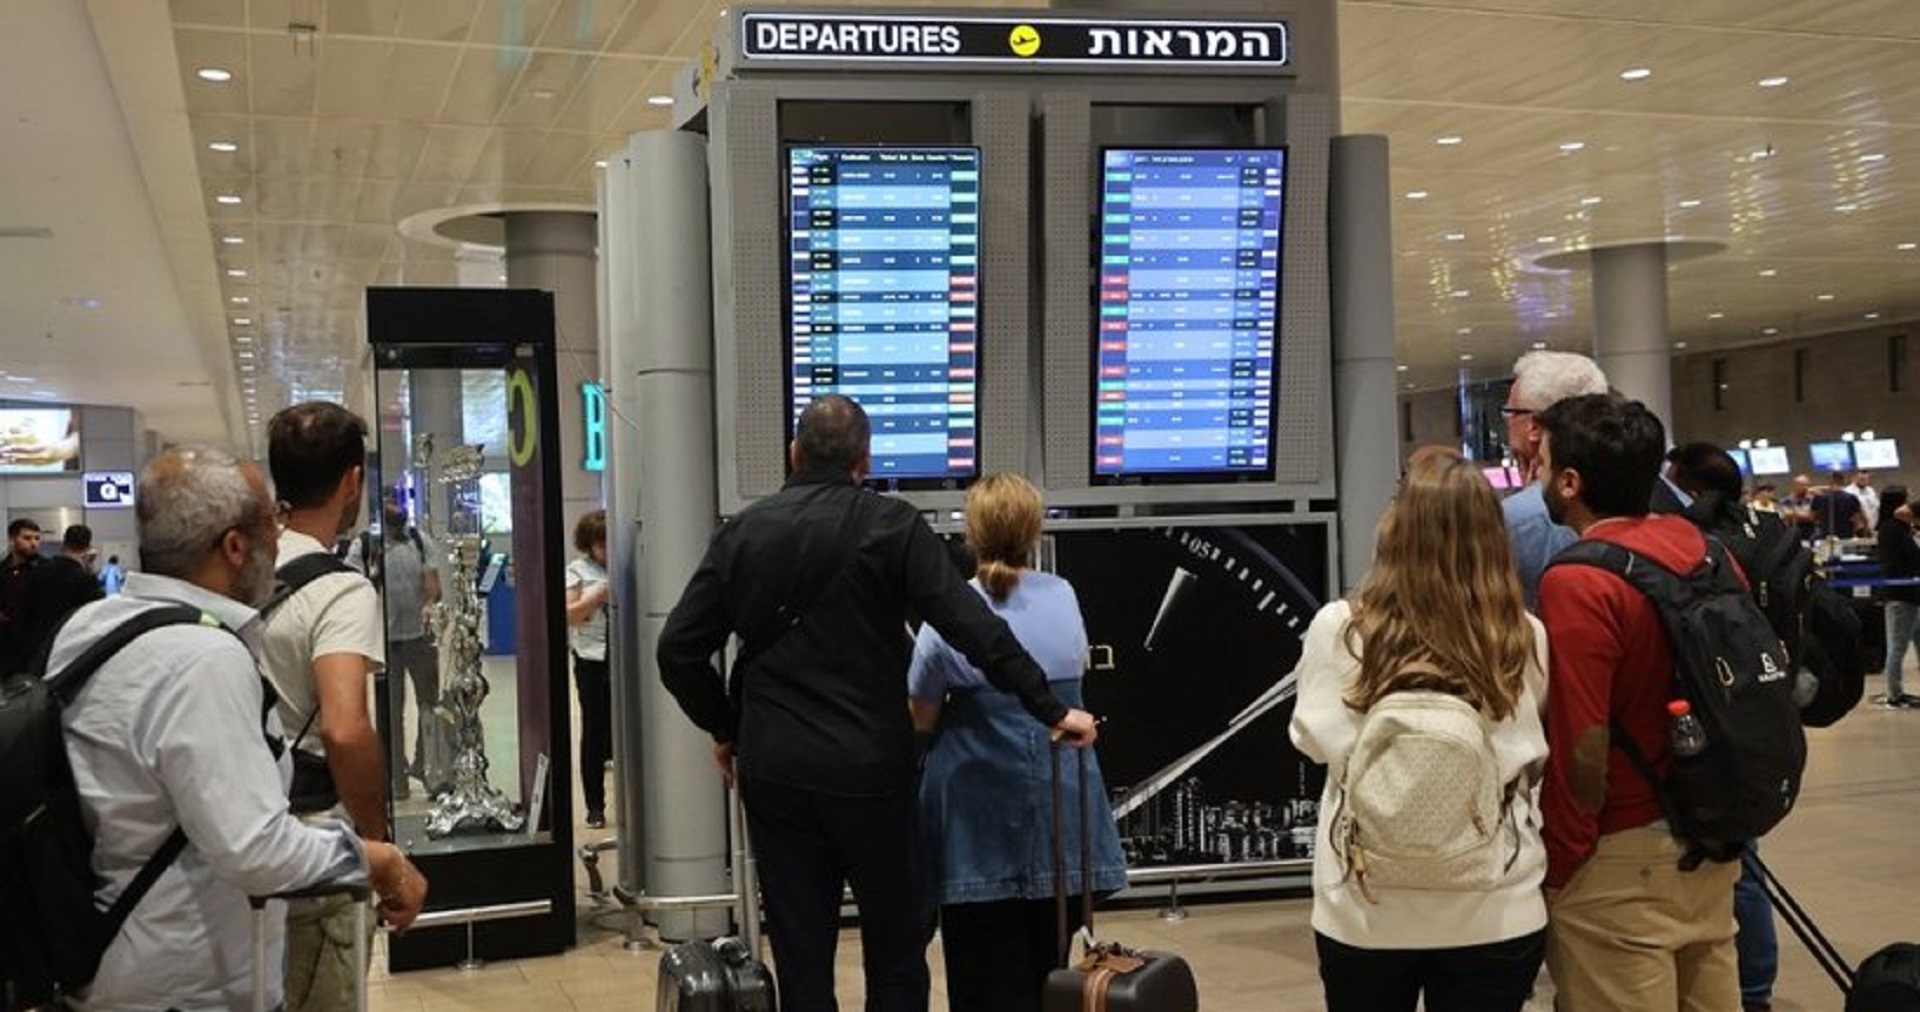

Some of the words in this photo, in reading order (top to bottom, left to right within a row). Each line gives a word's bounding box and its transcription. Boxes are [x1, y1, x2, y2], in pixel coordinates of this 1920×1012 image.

[756, 22, 960, 54] DEPARTURES
[1088, 28, 1270, 57] המראות
[1188, 536, 1212, 559] 05
